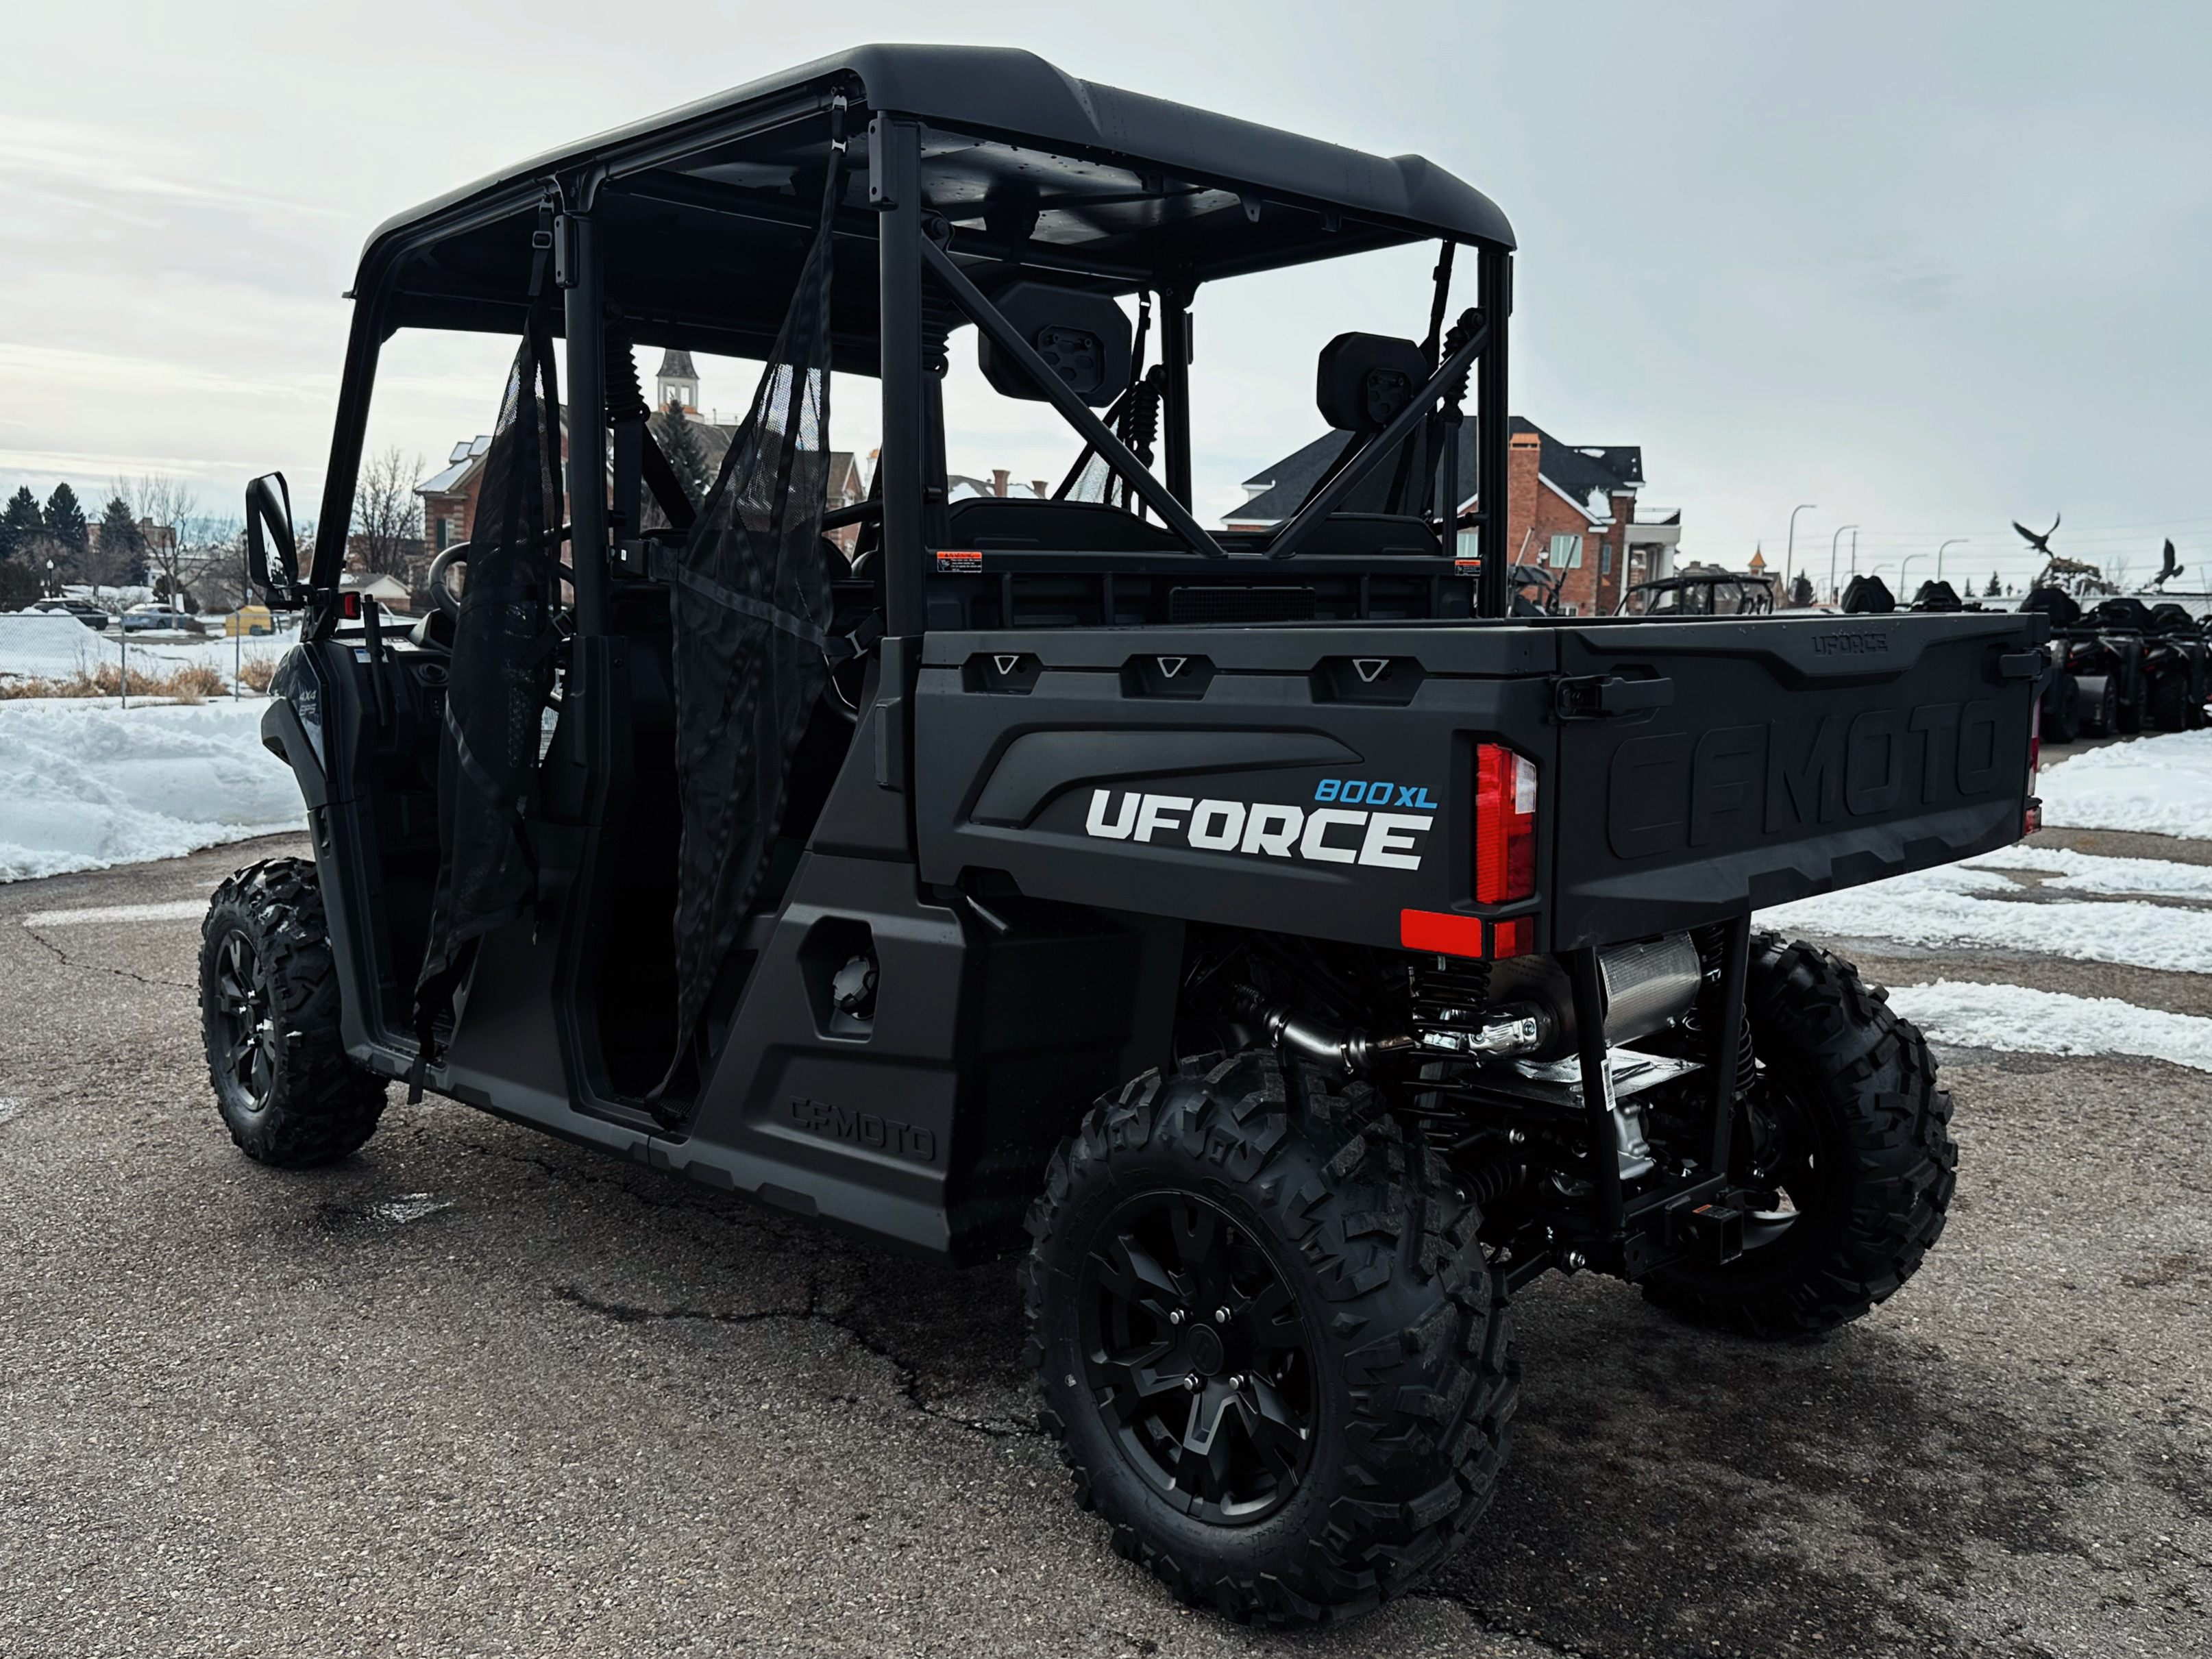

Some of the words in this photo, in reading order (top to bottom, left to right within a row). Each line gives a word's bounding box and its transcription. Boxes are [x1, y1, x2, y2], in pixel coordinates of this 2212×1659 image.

[1812, 633, 1889, 657] UFORCE
[299, 690, 317, 701] 4X4
[299, 704, 317, 716] EPS
[1608, 699, 2002, 860] CFMOTO
[1085, 789, 1434, 871] UFORCE
[789, 1095, 936, 1162] CFMOTO
